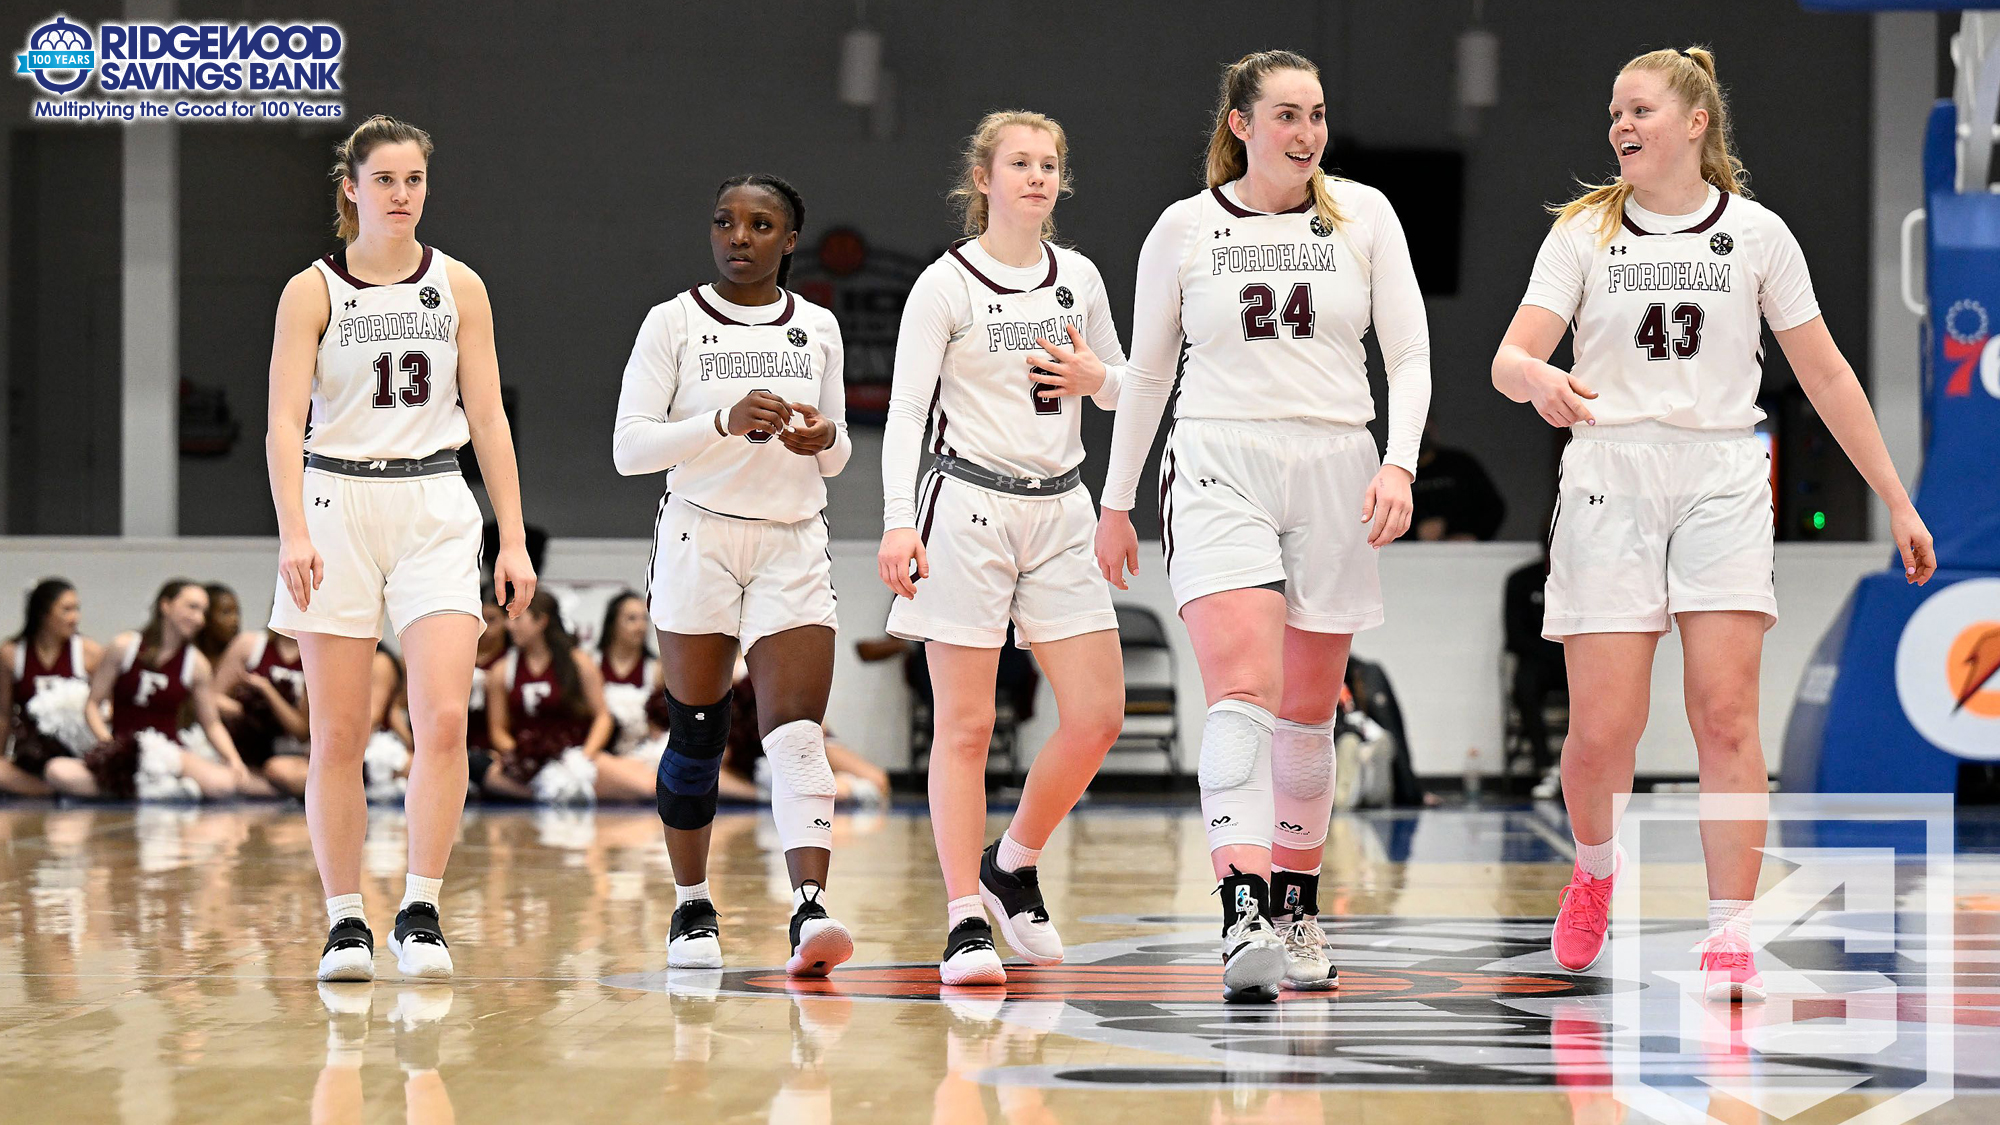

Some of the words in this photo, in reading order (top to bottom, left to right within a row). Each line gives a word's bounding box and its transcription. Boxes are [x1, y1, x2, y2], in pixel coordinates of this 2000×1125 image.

[1212, 244, 1336, 275] FORDHAM
[1608, 262, 1731, 293] FORDHAM
[339, 312, 451, 347] FORDHAM
[1240, 283, 1315, 341] 24
[1634, 302, 1705, 361] 43
[372, 351, 431, 409] 13
[700, 352, 813, 381] FORDHAM
[134, 670, 169, 706] F
